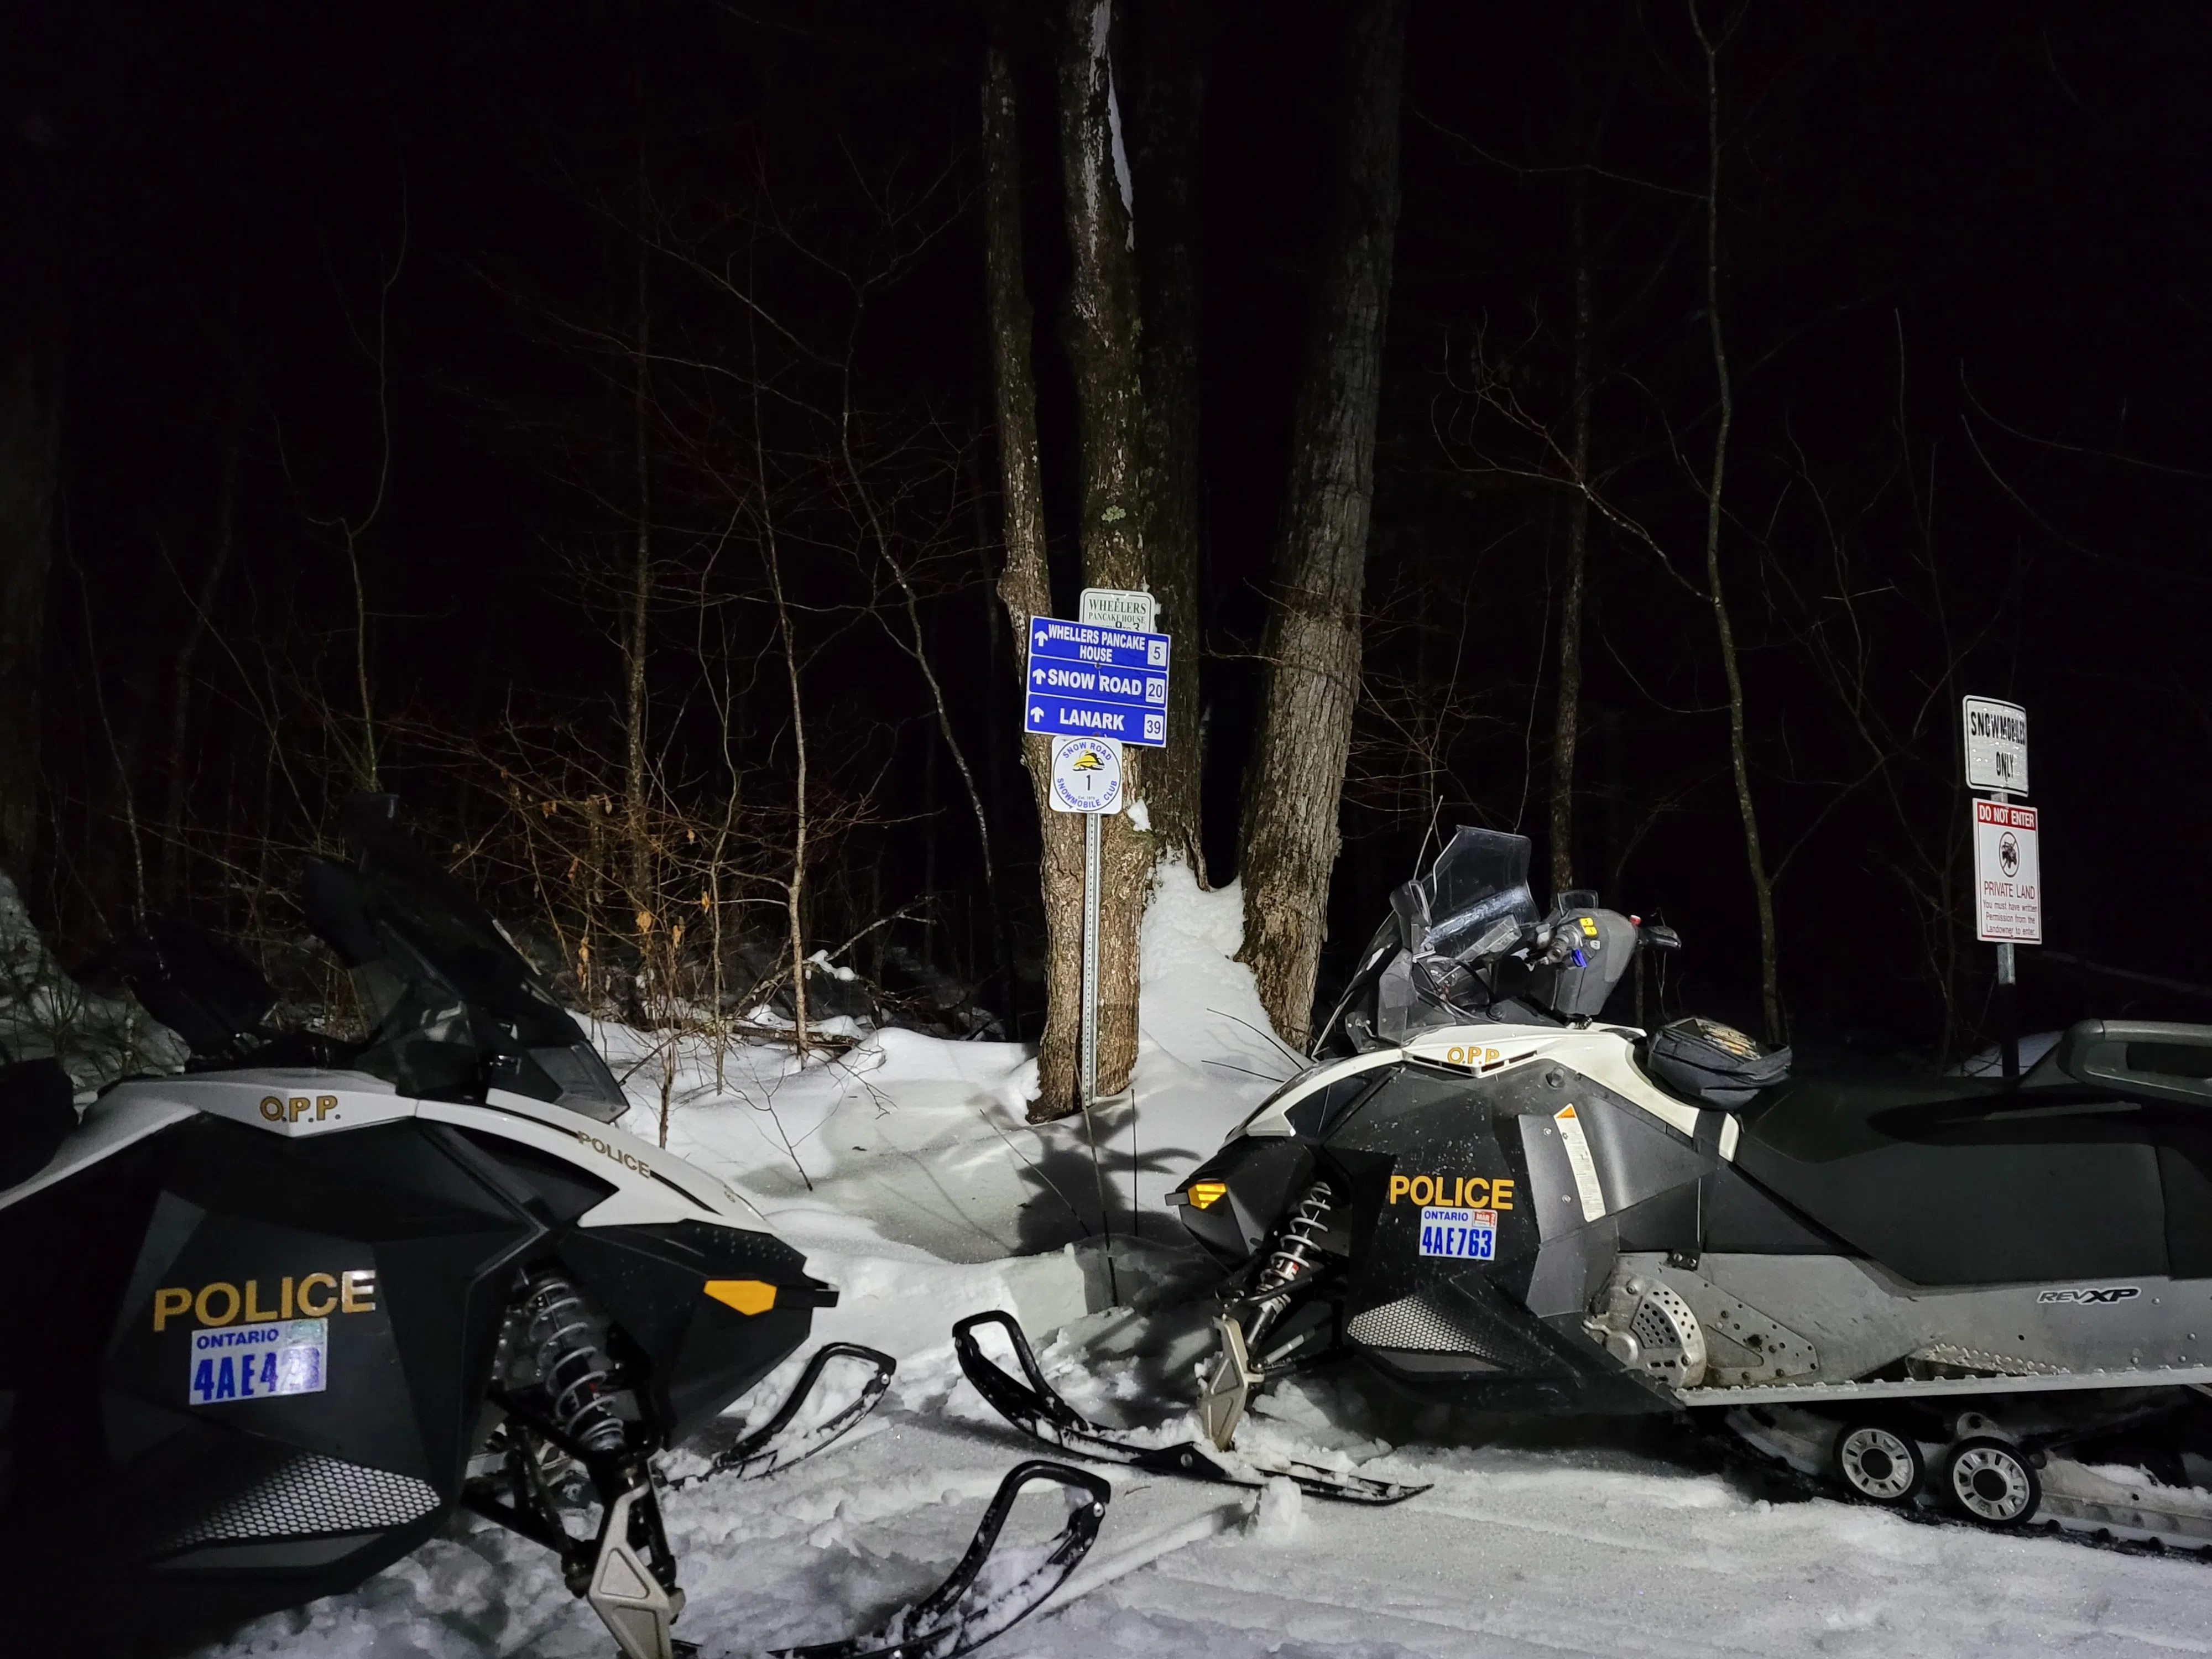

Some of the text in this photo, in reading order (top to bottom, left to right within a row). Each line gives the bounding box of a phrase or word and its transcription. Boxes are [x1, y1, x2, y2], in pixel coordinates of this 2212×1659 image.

[1089, 599, 1146, 614] WHEELERS
[1089, 612, 1146, 624] PANCAKE HOUSE
[1048, 624, 1145, 650] WHELLERS PANCAKE
[1079, 645, 1112, 662] HOUSE
[1154, 646, 1161, 660] 5
[1047, 669, 1142, 696] SNOW ROAD
[1148, 684, 1162, 698] 20
[1060, 708, 1124, 731] LANARK
[1146, 720, 1161, 734] 39
[1062, 742, 1112, 760] SNOW ROAD
[1996, 752, 2013, 779] ONLY
[1086, 774, 1091, 791] 1
[1057, 778, 1117, 808] SNOWMOBILE CLUB
[1979, 805, 2034, 827] DO NOT ENTER
[1984, 880, 2035, 900] PRIVATE LAND
[1983, 899, 2037, 912] You must have written
[1986, 911, 2013, 922] Permission
[2015, 914, 2026, 923] from
[1986, 924, 2013, 934] Landowner
[2016, 926, 2021, 935] to
[577, 1131, 650, 1178] POLICE
[1390, 1175, 1515, 1210] POLICE
[1424, 1211, 1469, 1222] ONTARIO
[1422, 1226, 1493, 1258] 4AE763
[153, 1270, 376, 1332] POLICE
[196, 1328, 279, 1350] ONTARIO
